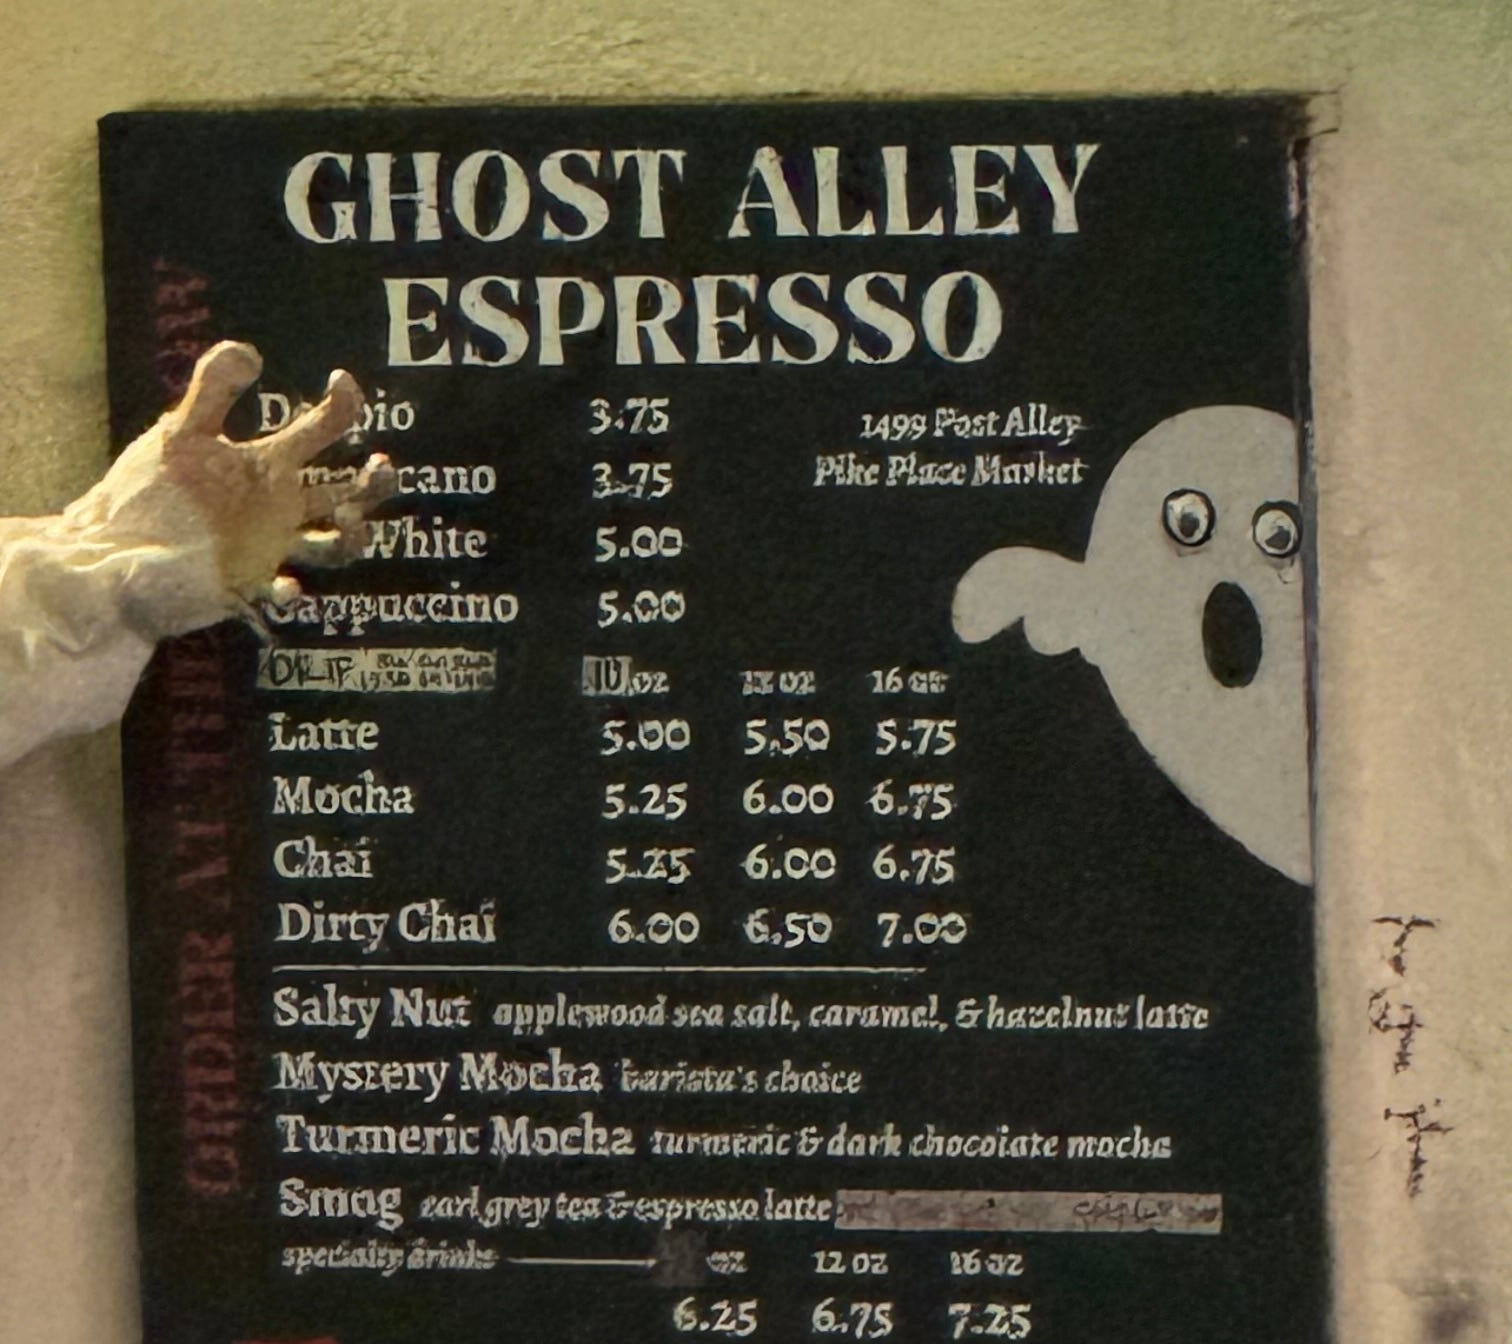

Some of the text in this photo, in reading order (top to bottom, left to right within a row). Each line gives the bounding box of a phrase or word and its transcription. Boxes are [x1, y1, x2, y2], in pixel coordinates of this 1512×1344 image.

[283, 143, 1100, 244] GHOST ALLEY
[383, 270, 1003, 368] ESPRESSO
[589, 397, 670, 435] 3.75
[859, 402, 1083, 447] 1499 Post Alley
[592, 462, 673, 499] 3.75
[813, 450, 1089, 487] Pike Place Market
[595, 525, 684, 563] 5.00
[597, 590, 686, 629] 5.00
[871, 666, 904, 694] 16
[268, 711, 957, 757] Latte 5.00 5.50 5.75
[272, 769, 955, 821] Mocha 5.25 6.00 6.75
[273, 835, 956, 885] Chai 5.25 6.00 6.75
[274, 898, 968, 954] Dirty Chai 6.00 6.50 7.00
[273, 982, 381, 1040] Salty
[389, 987, 472, 1028] Nut
[492, 992, 668, 1036] applewood
[671, 1004, 724, 1028] sea
[730, 992, 801, 1032] salt,
[955, 997, 984, 1029] &
[986, 994, 1131, 1030] hazelnut
[1135, 994, 1209, 1031] latte
[273, 1047, 862, 1104] Mystery Mocha barista's choice
[275, 1111, 1172, 1160] Turmeric Mocha turmeric & dark chocolate mocha
[420, 1185, 481, 1219] earl
[483, 1194, 551, 1229] grey
[555, 1192, 603, 1222] tea
[634, 1196, 760, 1231] espresso
[763, 1187, 833, 1222] latte
[281, 1238, 405, 1278] specialty
[406, 1237, 499, 1270] drinks
[813, 1250, 847, 1274] 12
[851, 1252, 889, 1275] oz
[673, 1296, 1032, 1340] 6.25 6.75 7.25
